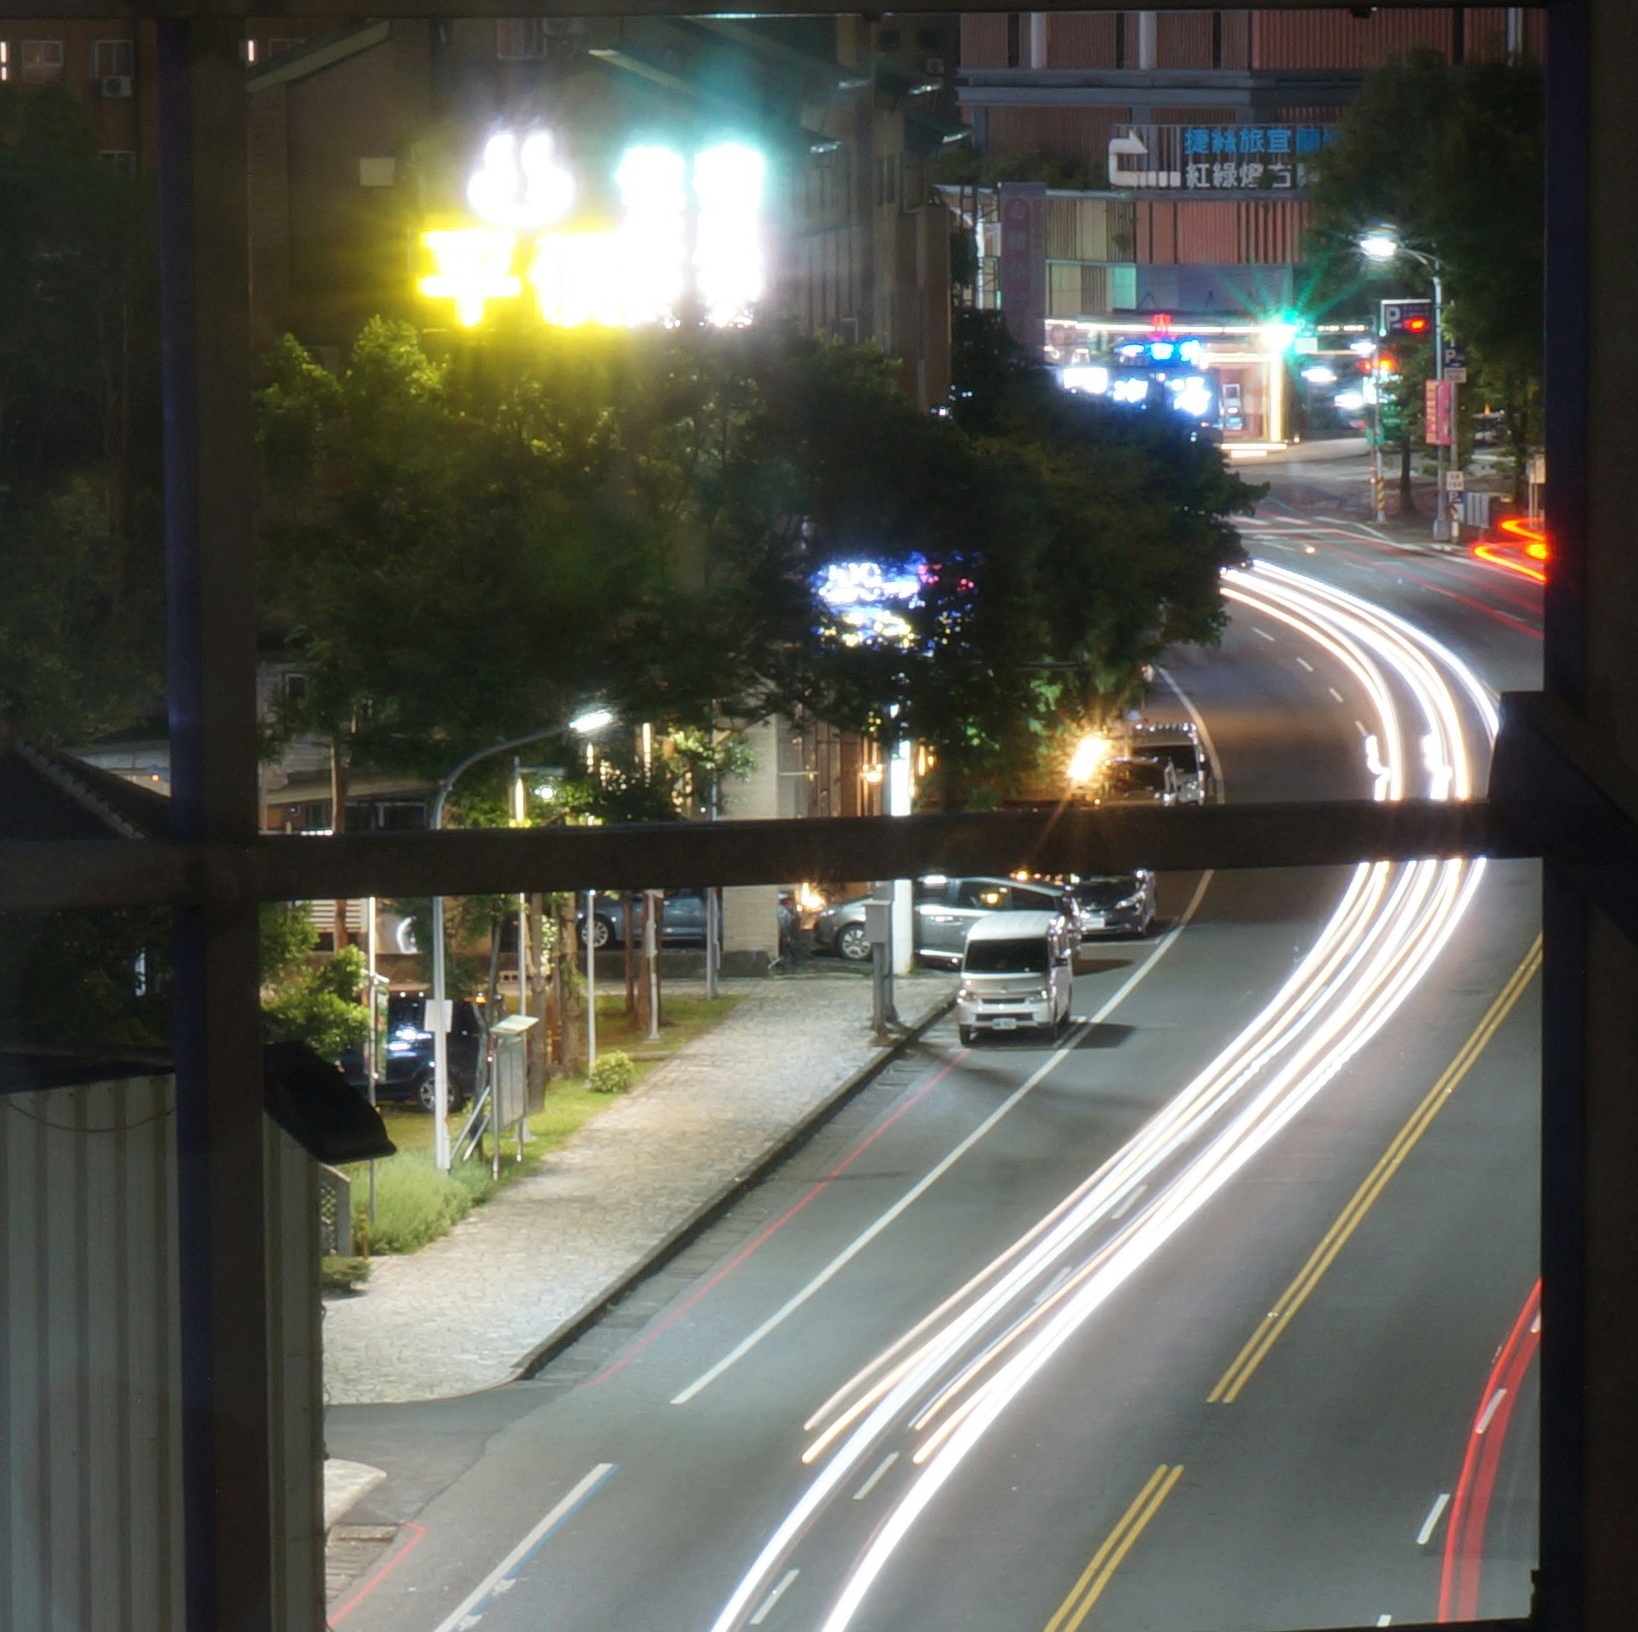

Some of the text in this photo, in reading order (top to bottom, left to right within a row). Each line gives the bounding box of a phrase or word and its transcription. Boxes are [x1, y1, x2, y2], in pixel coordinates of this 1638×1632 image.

[1185, 128, 1343, 155] 捷絲旅宜蘭
